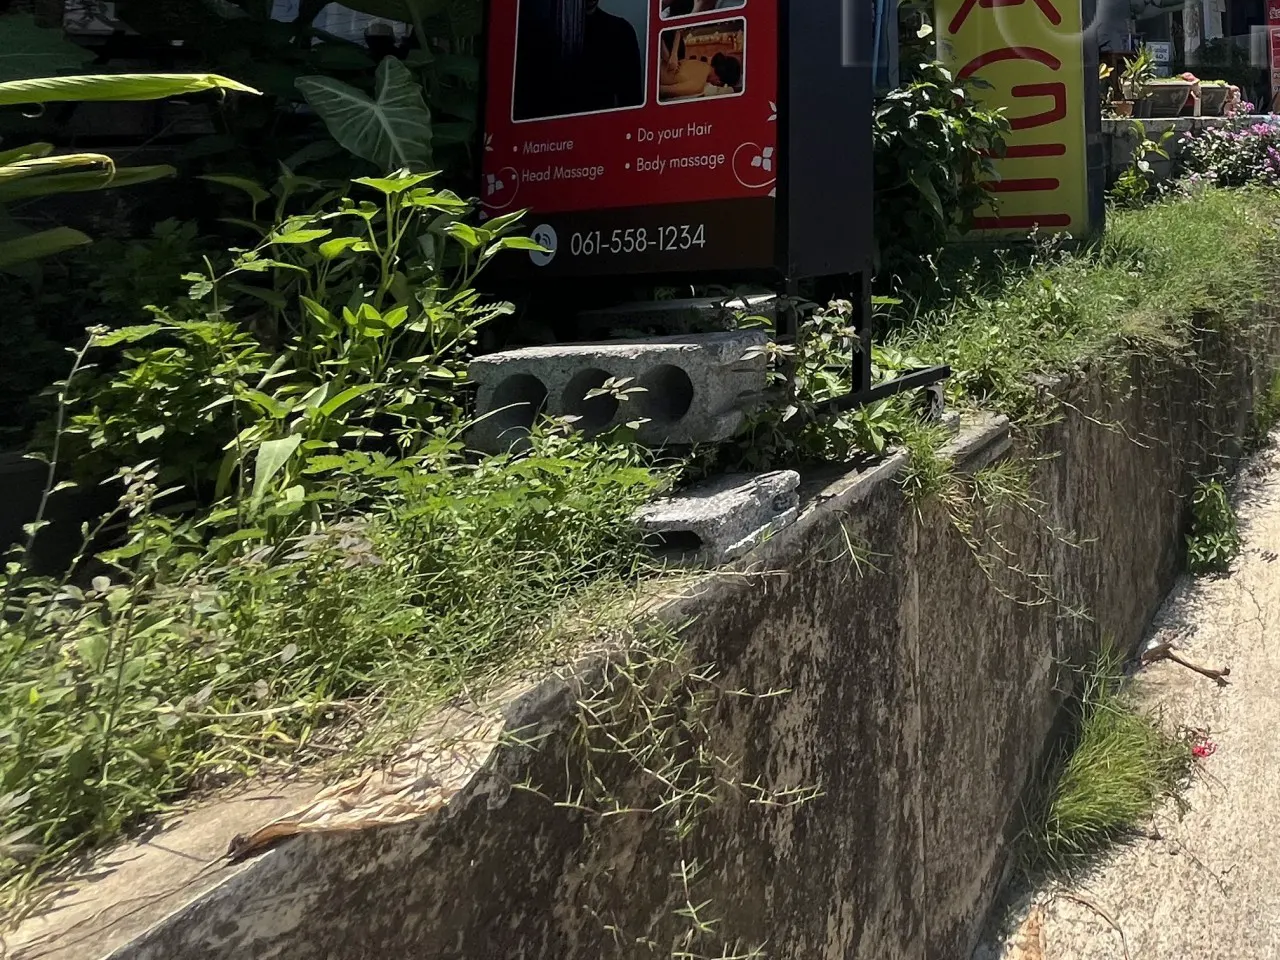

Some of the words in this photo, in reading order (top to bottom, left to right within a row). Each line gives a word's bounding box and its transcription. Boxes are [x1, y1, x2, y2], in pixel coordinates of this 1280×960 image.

[637, 128, 654, 142] Do
[657, 129, 683, 145] your
[687, 122, 713, 136] Hair
[522, 139, 574, 155] Manicure
[636, 157, 666, 173] Body
[669, 152, 725, 170] massage
[521, 167, 550, 183] Head
[553, 164, 604, 180] Massage
[570, 224, 706, 256] 061-558-1234
